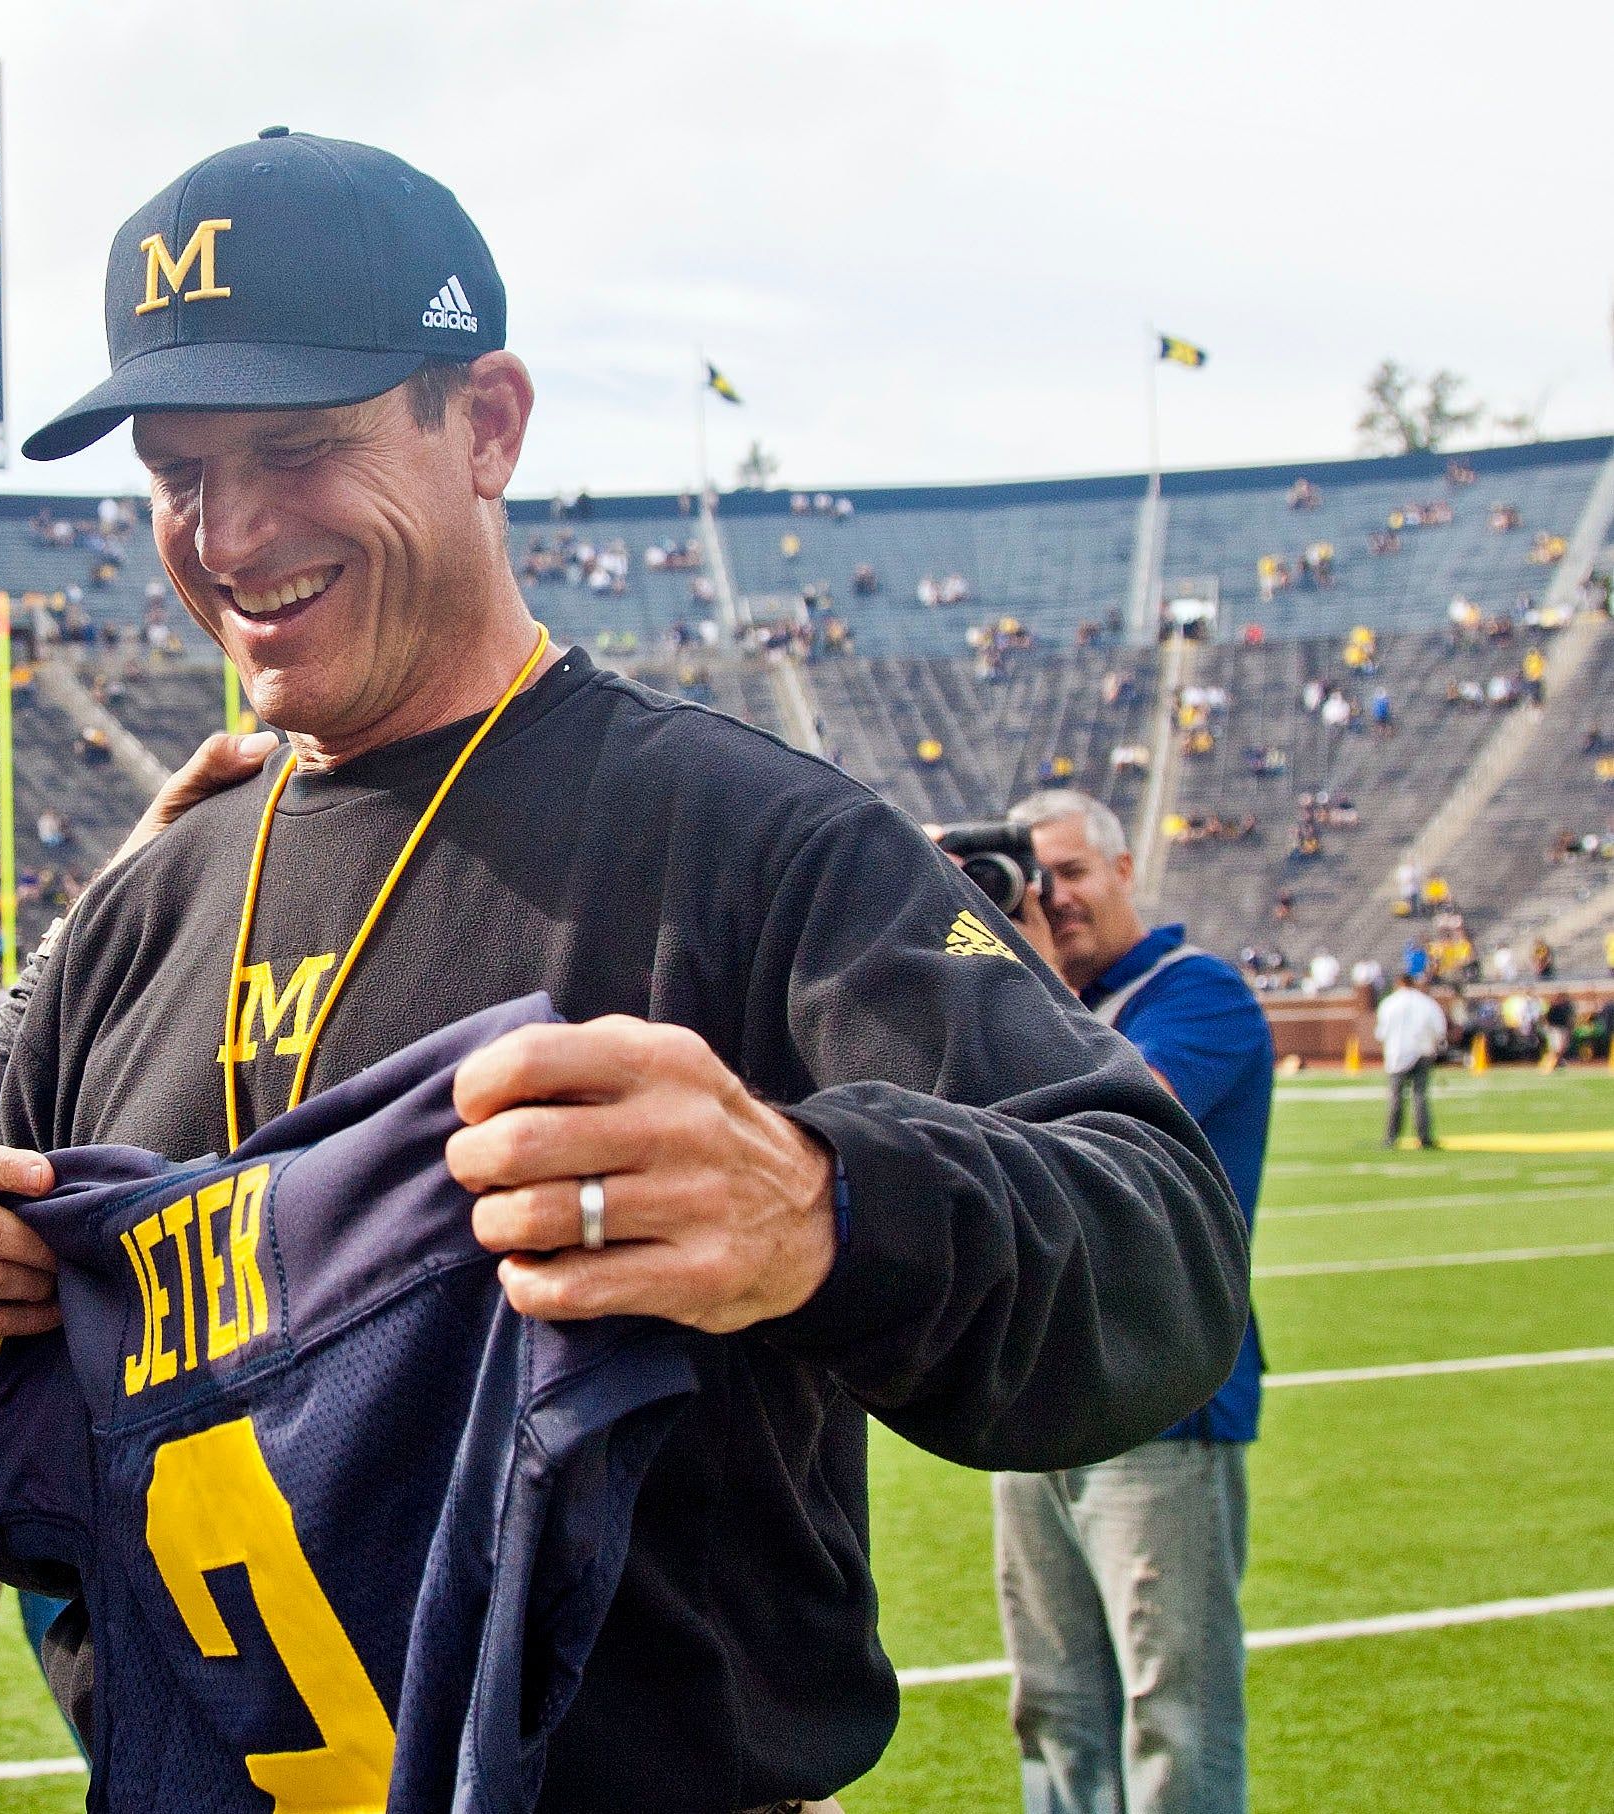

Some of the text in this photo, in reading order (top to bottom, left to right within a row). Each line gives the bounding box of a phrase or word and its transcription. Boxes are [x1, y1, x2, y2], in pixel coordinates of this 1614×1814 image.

[135, 218, 232, 316] M
[422, 307, 478, 333] adidas
[216, 953, 336, 1062] M
[120, 1162, 272, 1396] JETER
[146, 1415, 398, 1814] 2
